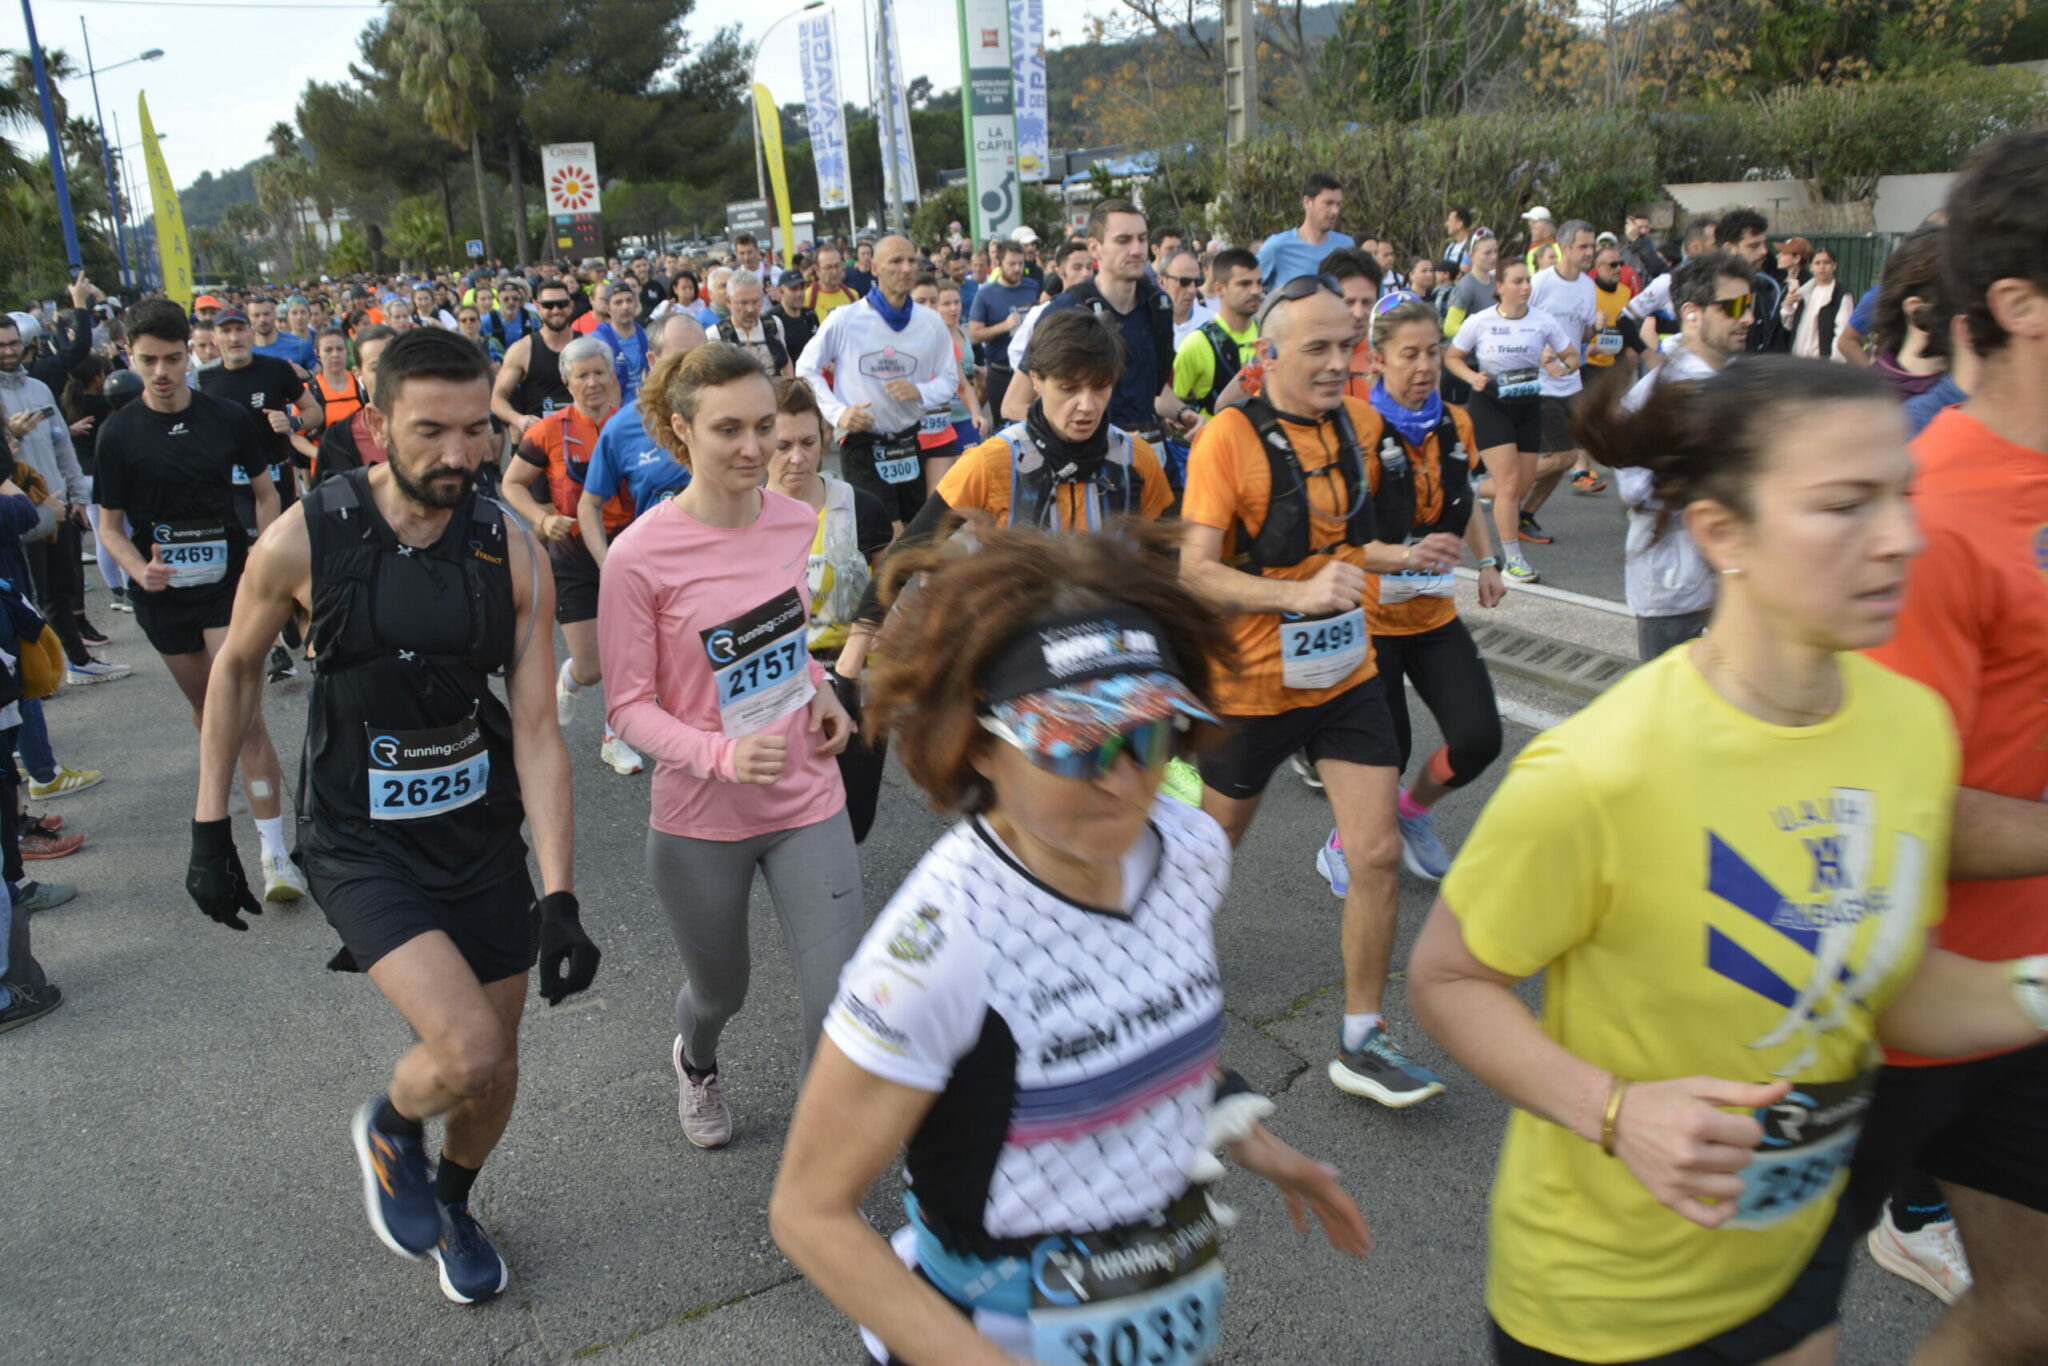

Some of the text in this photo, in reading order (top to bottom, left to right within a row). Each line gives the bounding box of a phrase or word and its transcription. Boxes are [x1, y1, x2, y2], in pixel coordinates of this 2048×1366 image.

[988, 128, 1003, 137] LA
[977, 141, 1013, 151] CAPTE
[1600, 336, 1619, 346] 2041
[881, 462, 912, 478] 2300
[162, 546, 214, 564] 2469
[737, 602, 803, 645] runningconseil
[1294, 620, 1354, 657] 2499
[729, 642, 797, 698] 2757
[404, 728, 480, 758] runningconseil
[383, 768, 471, 807] 2625
